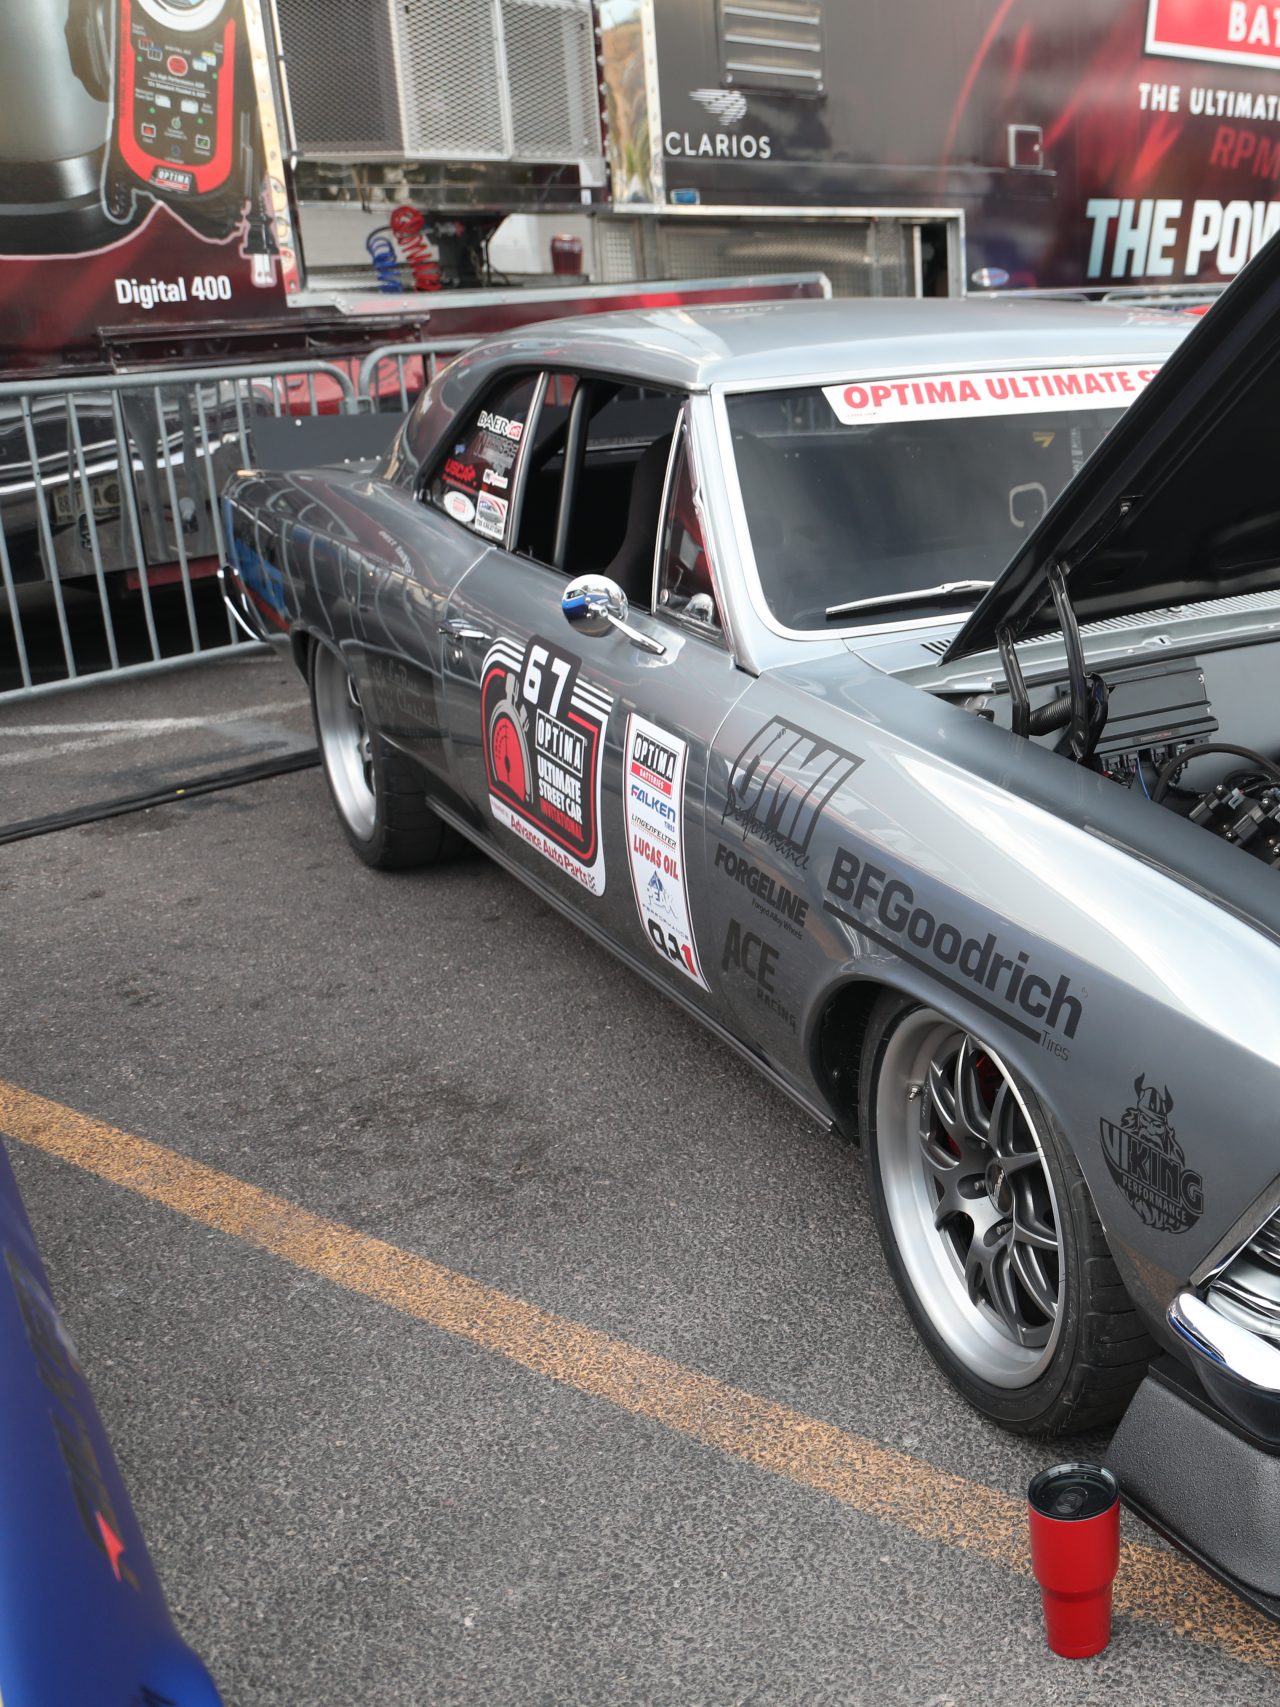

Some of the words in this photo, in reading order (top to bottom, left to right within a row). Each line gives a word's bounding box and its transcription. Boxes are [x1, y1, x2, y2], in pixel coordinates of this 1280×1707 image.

[1138, 83, 1181, 114] THE
[665, 131, 771, 159] CLARIOS
[157, 170, 192, 185] OPTIMA
[1086, 198, 1182, 278] THE
[115, 276, 187, 309] Digital
[191, 275, 232, 301] 400
[843, 379, 982, 409] OPTIMA
[985, 370, 1137, 400] ULTIMATE
[477, 410, 509, 436] BAER
[523, 644, 571, 718] 67
[537, 718, 581, 771] OPTIMA
[634, 737, 674, 779] OPTIMA
[537, 754, 582, 804] ULTIMATE
[538, 778, 565, 811] STREET
[565, 796, 583, 825] CAR
[639, 768, 665, 790] BATTERIES
[631, 784, 676, 823] FALKEN
[721, 784, 808, 870] Performance
[511, 814, 543, 850] Advance
[543, 840, 564, 867] Auto
[563, 855, 589, 887] Parts
[631, 813, 677, 848] LINGENFELTER
[633, 834, 662, 869] LUCAS
[664, 855, 680, 881] OIL
[714, 842, 809, 929] FORGELINE
[647, 917, 698, 978] QA1
[721, 917, 780, 993] ACE
[826, 846, 1084, 1040] BFGoodrich
[1040, 1028, 1070, 1062] Tires
[1100, 1116, 1204, 1215] VIKING
[1122, 1174, 1188, 1224] PERFORMANCE
